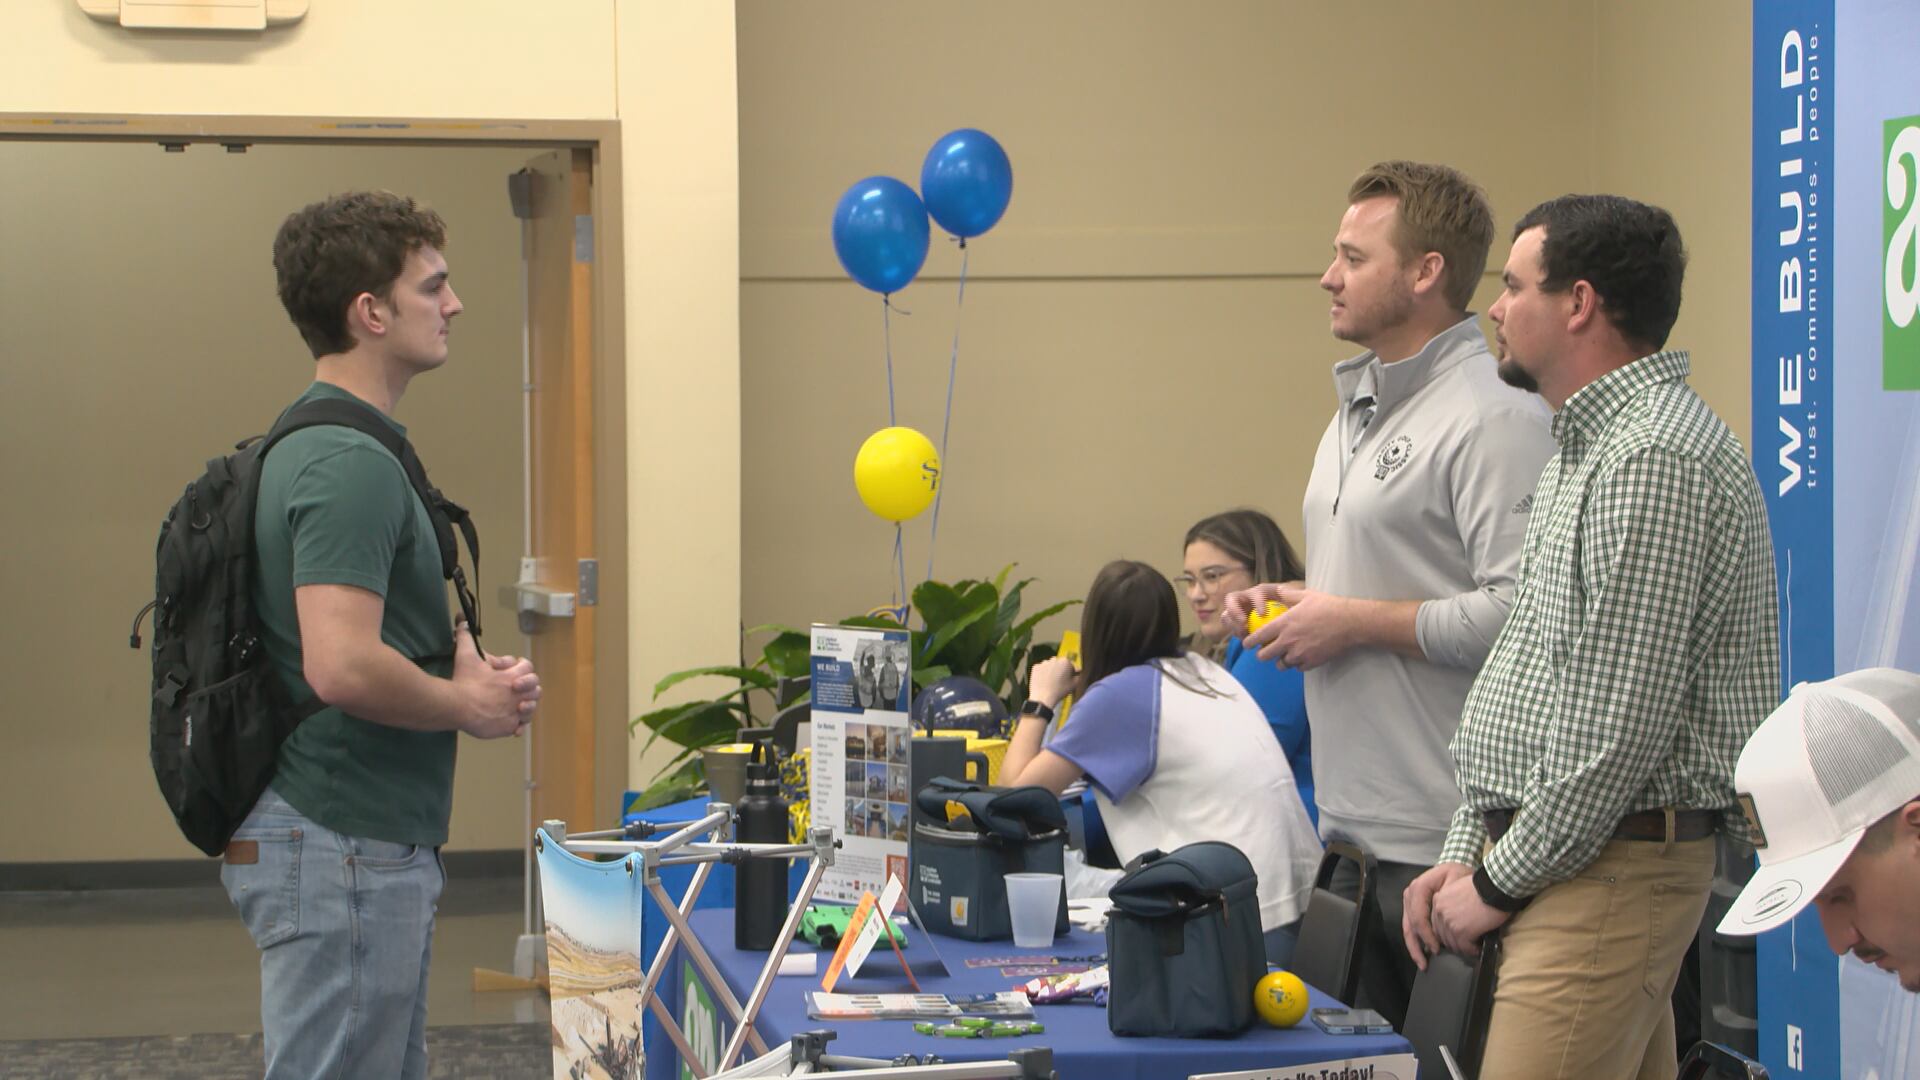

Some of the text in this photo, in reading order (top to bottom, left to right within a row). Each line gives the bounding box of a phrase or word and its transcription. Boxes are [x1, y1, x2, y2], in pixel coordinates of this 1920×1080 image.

[1779, 29, 1803, 498] WE BUILD
[1806, 24, 1820, 489] trust. communities. people.
[1319, 1064, 1375, 1080] Today!
